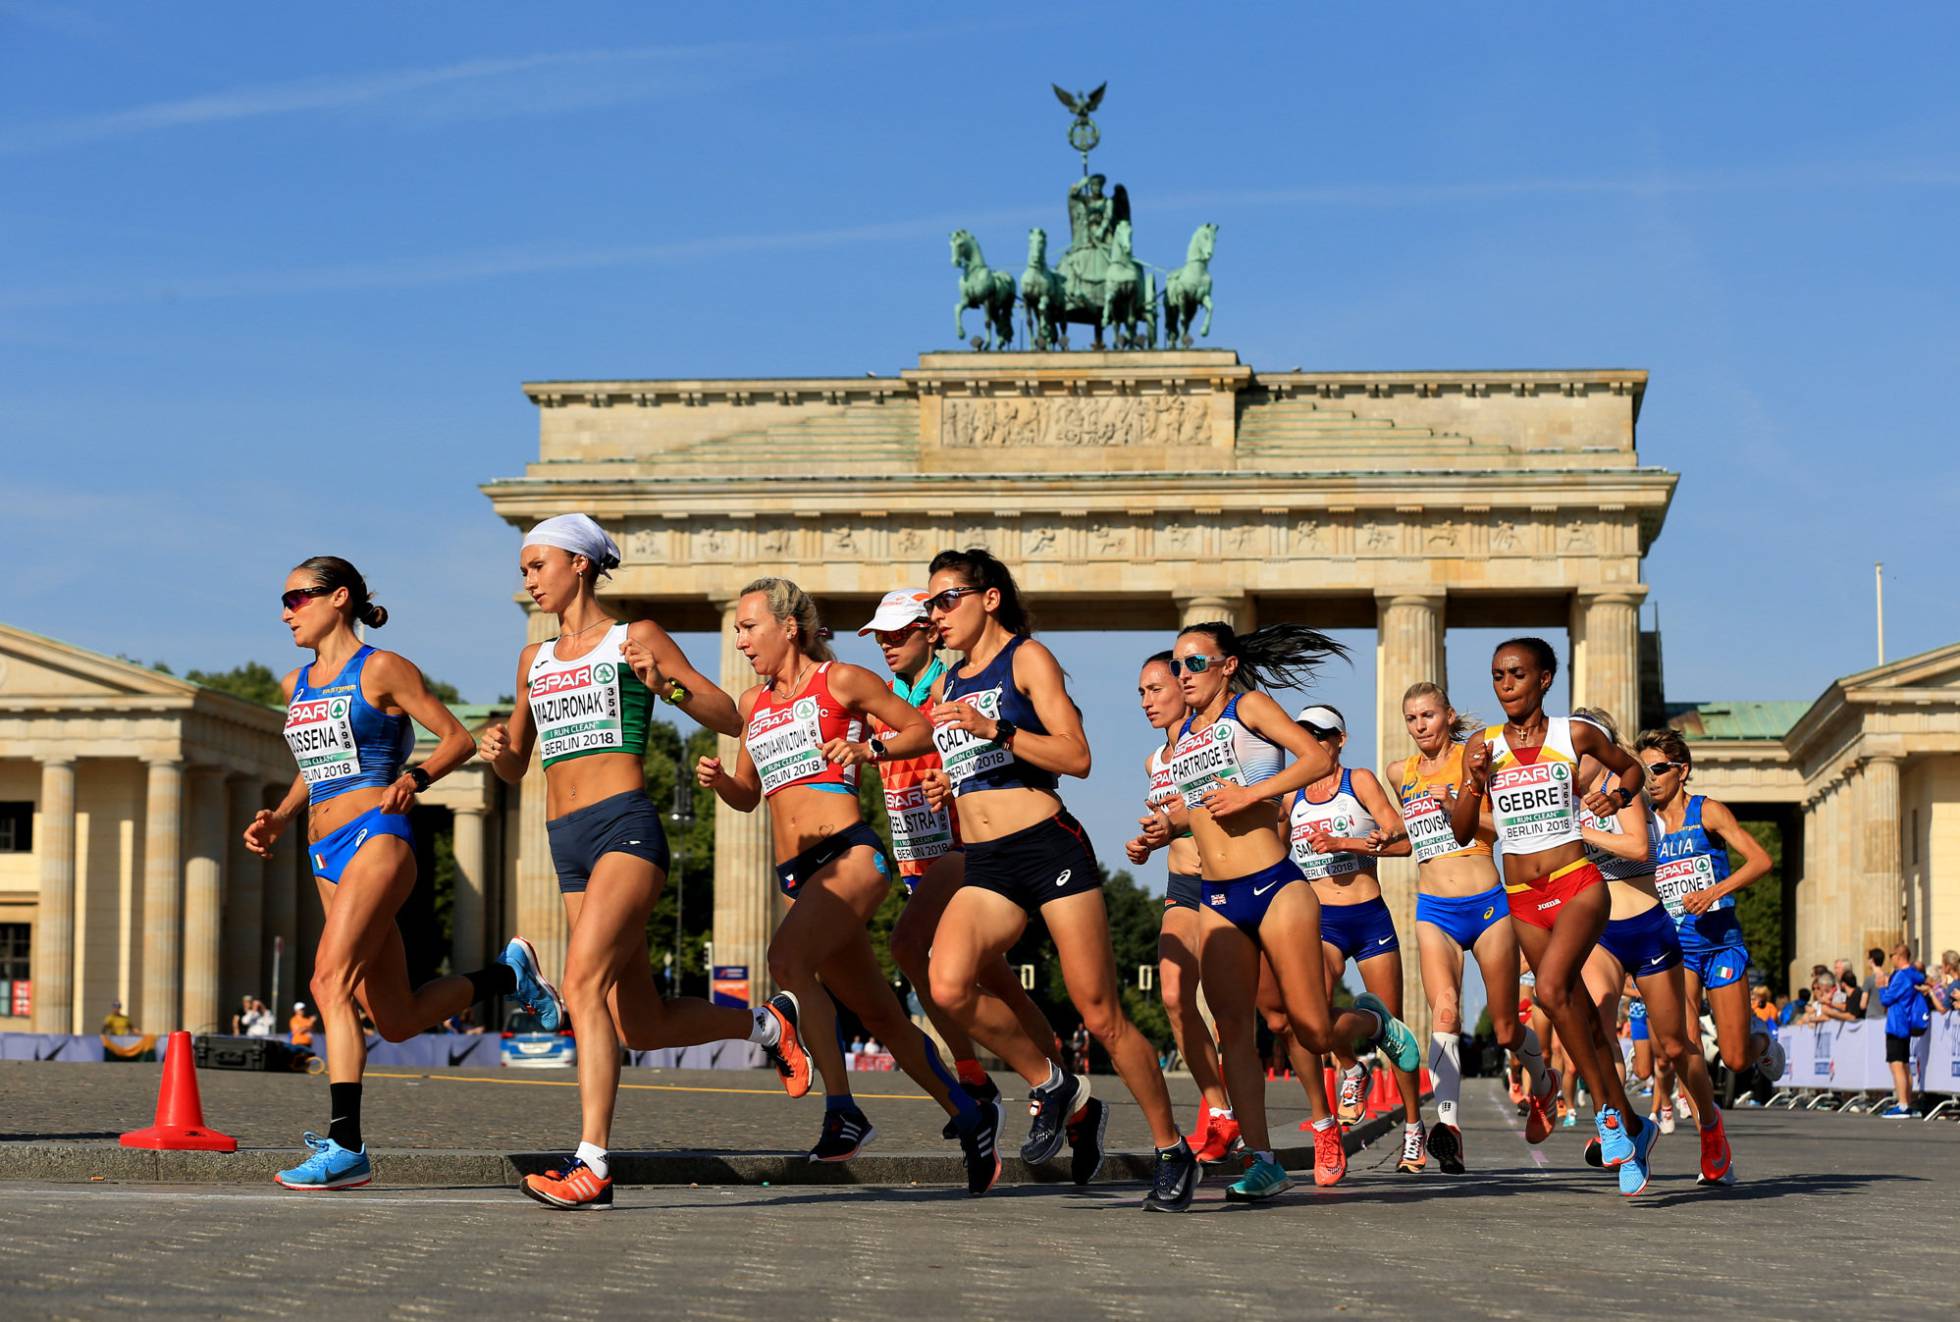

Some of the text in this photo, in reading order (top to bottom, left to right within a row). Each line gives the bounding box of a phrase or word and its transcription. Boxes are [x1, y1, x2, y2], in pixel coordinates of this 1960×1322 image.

[532, 668, 590, 695] SPAR
[534, 691, 603, 725] MAZURONAK
[607, 688, 616, 717] 354
[340, 721, 351, 749] 398
[554, 727, 570, 736] RUN
[571, 722, 596, 734] CLEAN
[749, 708, 793, 740] SPAR
[287, 726, 339, 754] OSSENA
[545, 732, 614, 756] BERLIN 2018
[937, 729, 977, 753] CALV
[1175, 729, 1212, 757] SPAR
[324, 763, 352, 778] 2018
[764, 760, 820, 789] BERLIN 2018
[948, 752, 1004, 779] BERLIN 2018
[1172, 746, 1223, 781] PARTRIDGE
[1492, 767, 1549, 790] SPAR
[886, 791, 923, 808] SAR
[1498, 786, 1560, 813] GEBRE
[889, 810, 937, 834] EELSTRA
[1507, 823, 1543, 838] BERLIN
[1546, 819, 1570, 832] 2018
[897, 843, 948, 859] BERLIN 2018
[1446, 841, 1458, 850] 20
[1656, 838, 1694, 858] ALIA
[1332, 863, 1353, 873] 2018
[1655, 861, 1694, 881] SPAR
[1657, 876, 1704, 899] BERTONE
